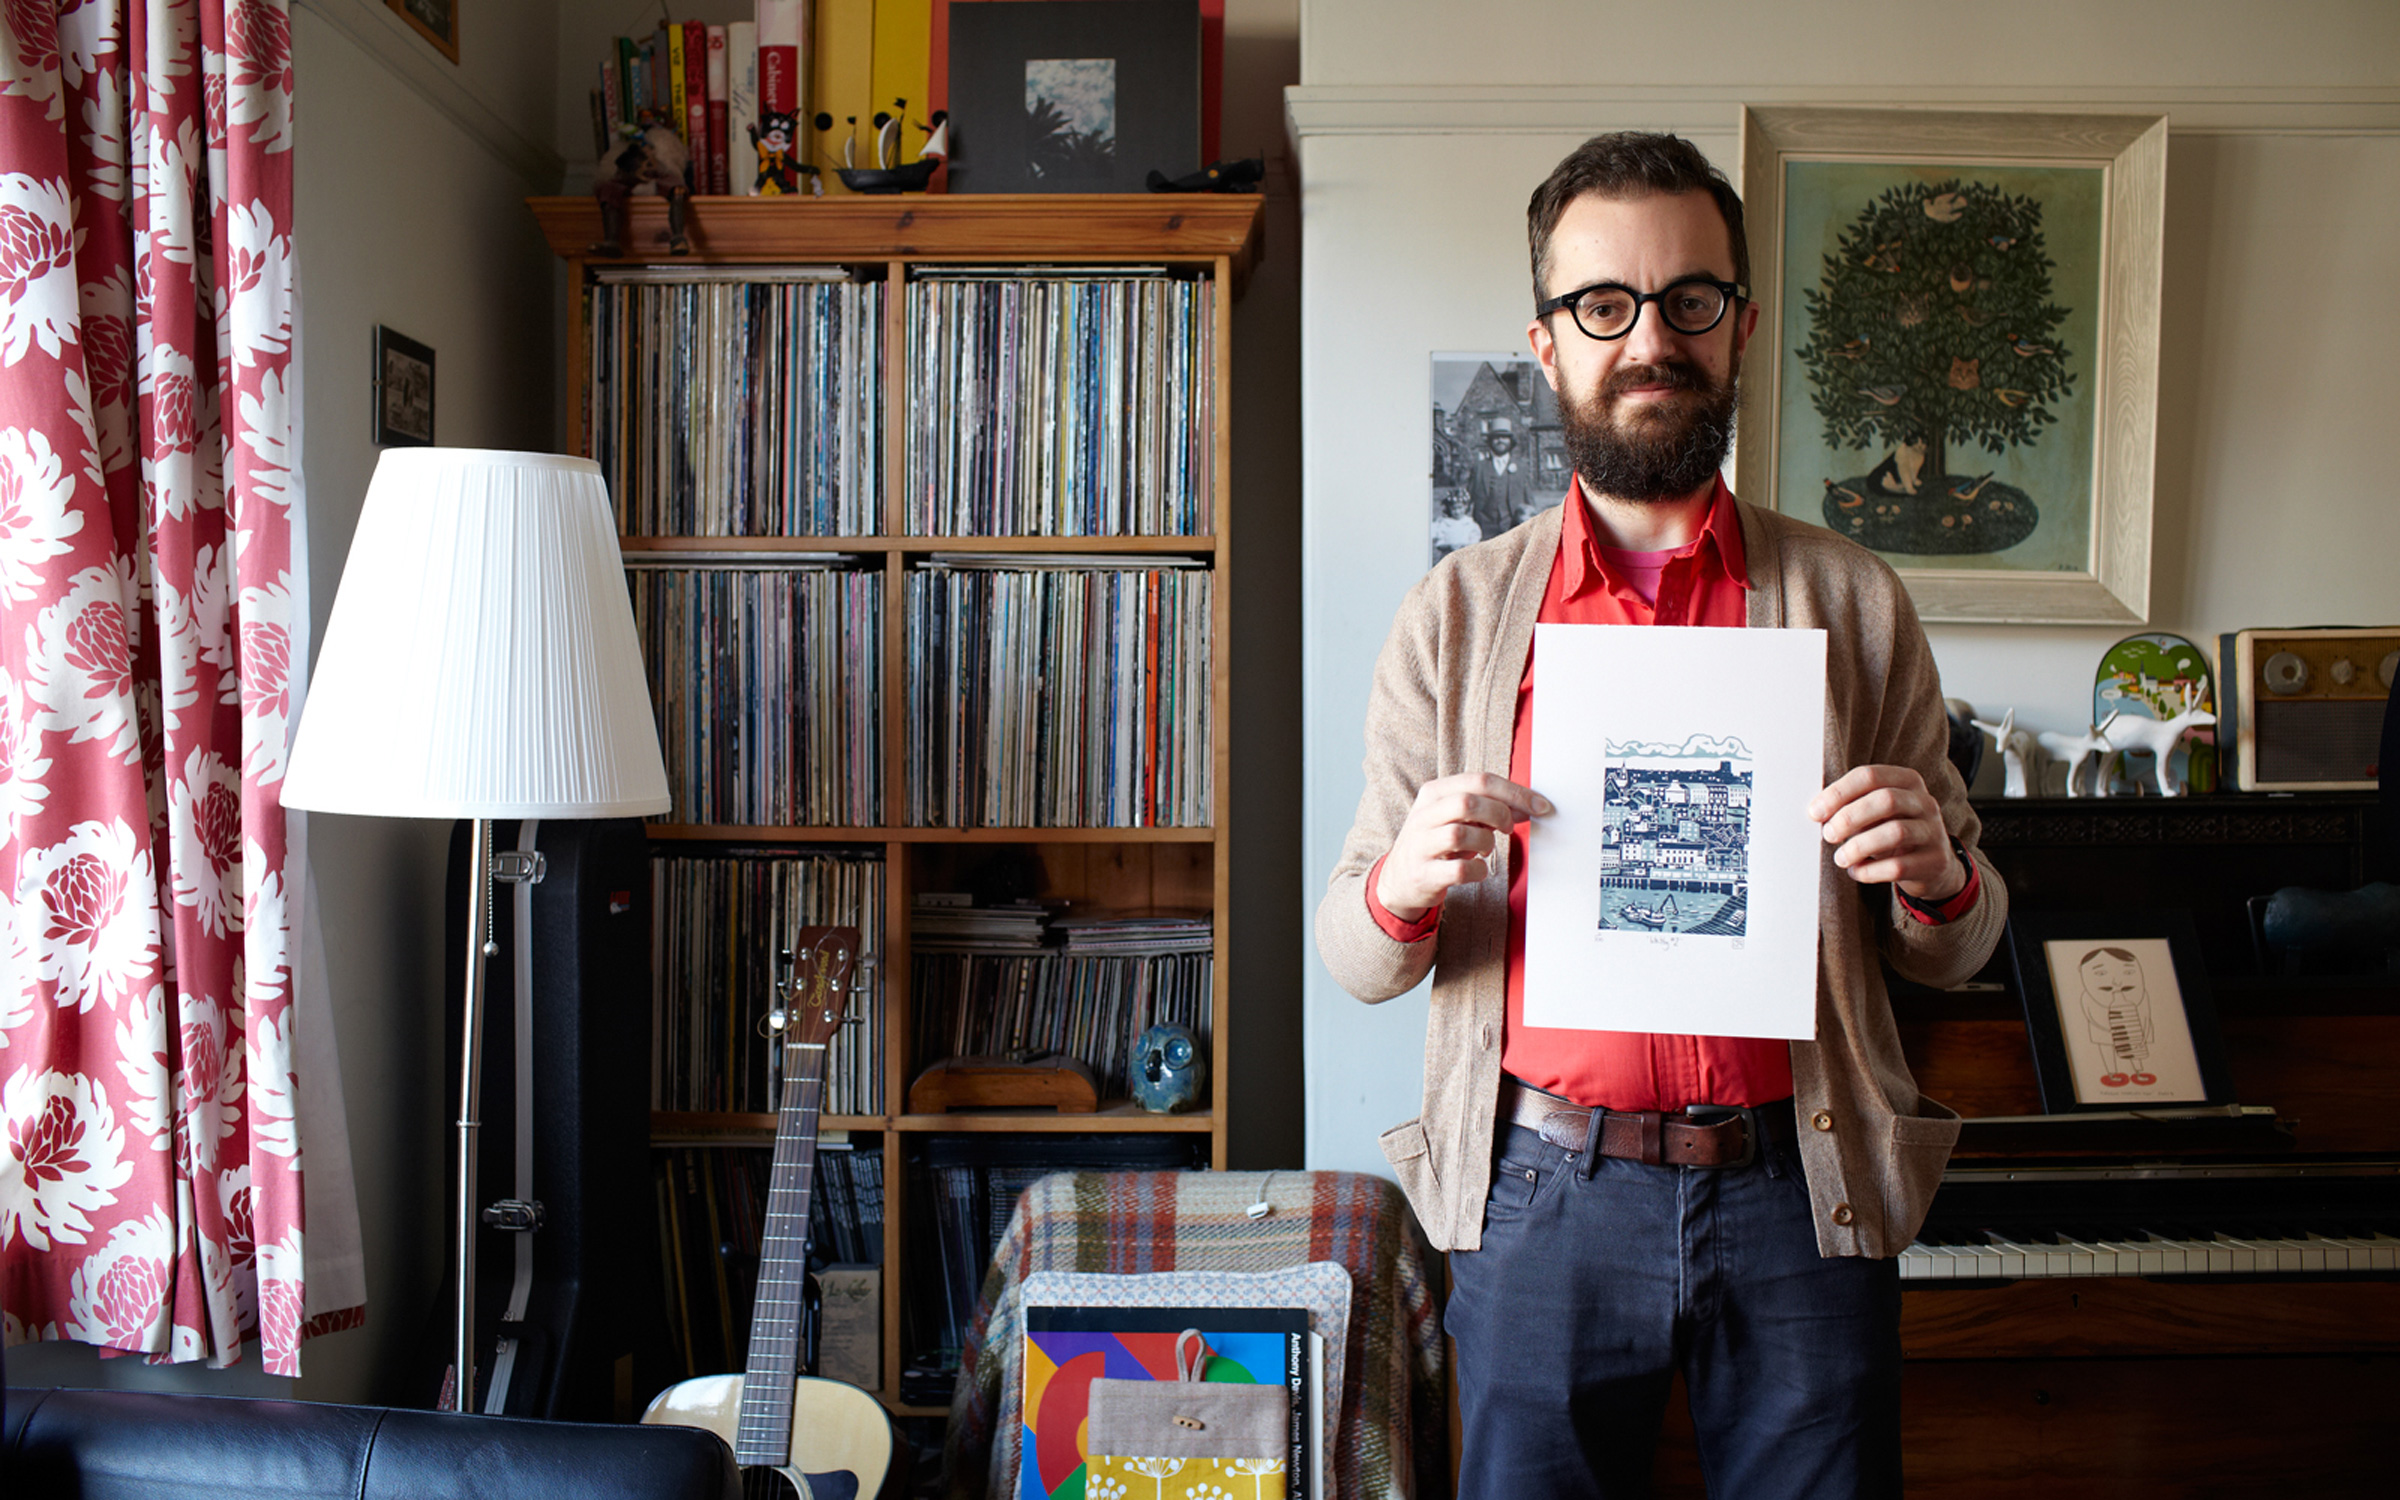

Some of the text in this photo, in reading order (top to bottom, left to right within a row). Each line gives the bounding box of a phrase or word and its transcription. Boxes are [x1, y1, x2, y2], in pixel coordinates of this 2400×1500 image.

[766, 51, 782, 105] Cabinet
[1289, 1333, 1301, 1376] Anthony
[1291, 1378, 1302, 1406] Davis,
[1291, 1409, 1302, 1443] James
[1290, 1445, 1302, 1488] Newton,
